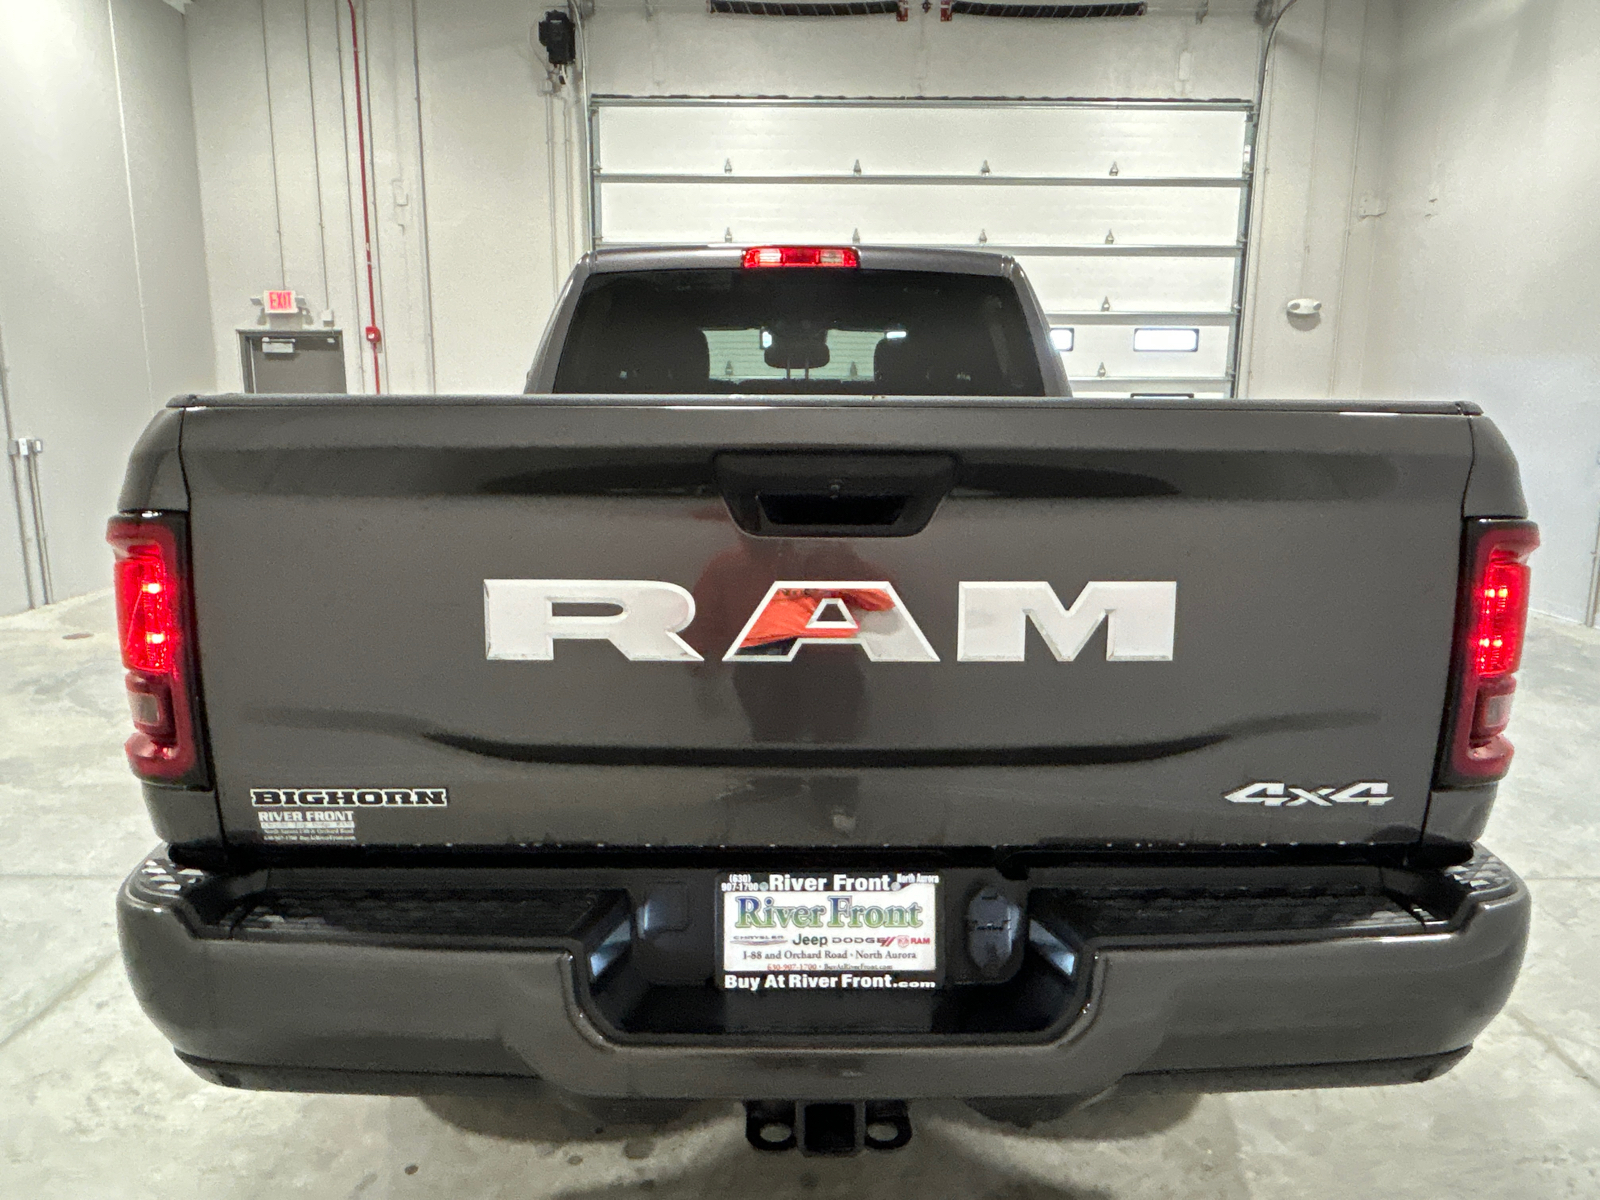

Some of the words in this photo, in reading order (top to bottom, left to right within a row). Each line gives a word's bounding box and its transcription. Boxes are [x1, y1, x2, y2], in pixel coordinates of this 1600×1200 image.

[268, 291, 293, 311] EXIT
[483, 579, 1178, 663] RAM
[250, 788, 448, 808] BIGHORN
[258, 811, 303, 821] RIVER
[306, 811, 354, 821] FRONT
[729, 874, 751, 883] (630)
[769, 874, 827, 891] River
[833, 874, 890, 891] Front
[721, 883, 758, 892] 907-1700
[735, 896, 826, 928] River
[827, 895, 923, 928] Front
[793, 933, 828, 947] Jeep
[910, 937, 930, 945] RAM
[743, 950, 762, 960] I-88
[765, 950, 782, 960] and
[784, 950, 822, 960] Orchard
[824, 950, 848, 960] Road
[855, 950, 882, 960] North
[885, 950, 917, 960] Aurora
[767, 963, 817, 971] 630-907-1700
[724, 974, 760, 992] Buy
[764, 973, 785, 988] At
[788, 973, 839, 989] River
